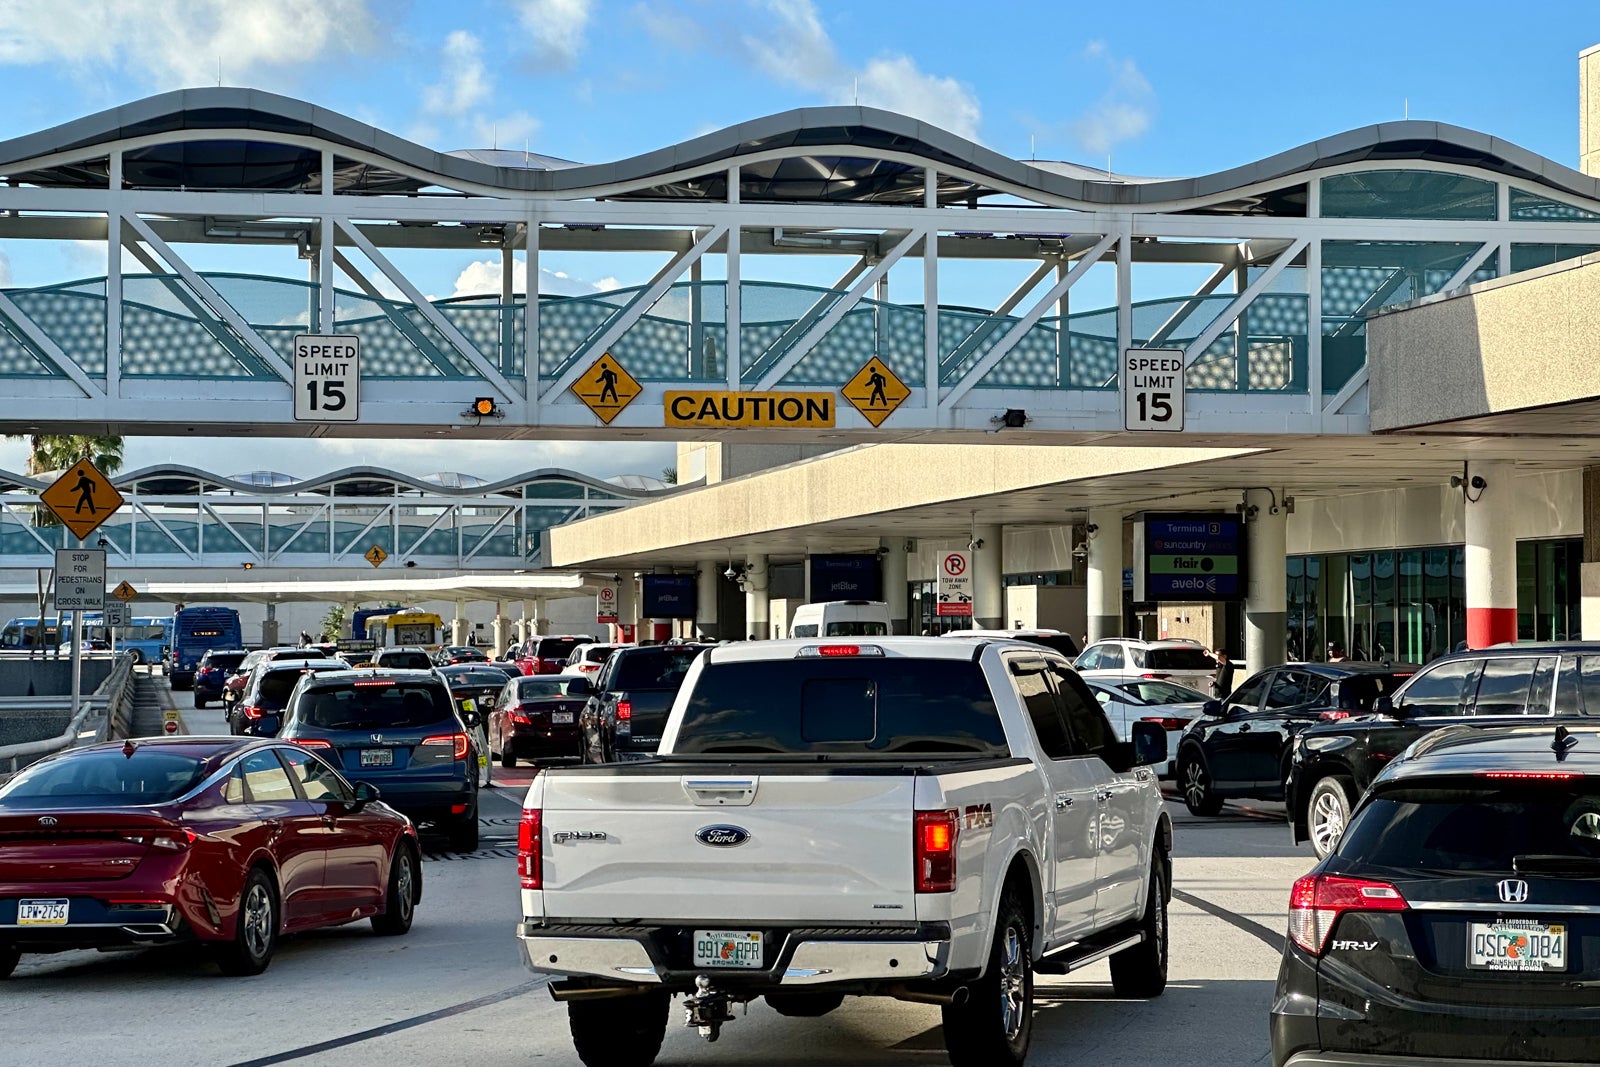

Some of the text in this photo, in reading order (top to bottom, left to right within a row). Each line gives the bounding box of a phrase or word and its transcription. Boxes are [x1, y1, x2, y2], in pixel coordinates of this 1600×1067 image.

[298, 345, 356, 359] SPEED
[305, 363, 349, 376] LIMIT
[1128, 358, 1181, 371] SPEED
[1134, 376, 1175, 389] LIMIT
[306, 380, 346, 412] 15
[671, 396, 829, 422] CAUTION
[1136, 392, 1173, 422] 15
[1168, 523, 1206, 533] Terminal
[72, 554, 90, 562] STOP
[1173, 557, 1199, 569] flair
[74, 565, 87, 573] FOR
[58, 576, 103, 584] PEDESTRIANS
[1171, 577, 1205, 589] avelo
[831, 581, 858, 592] jetBlue
[57, 597, 102, 606] CROSS WALK
[658, 593, 679, 603] jetBlue
[107, 614, 121, 625] 15
[707, 829, 738, 843] Ford
[1331, 940, 1379, 950] HR-V
